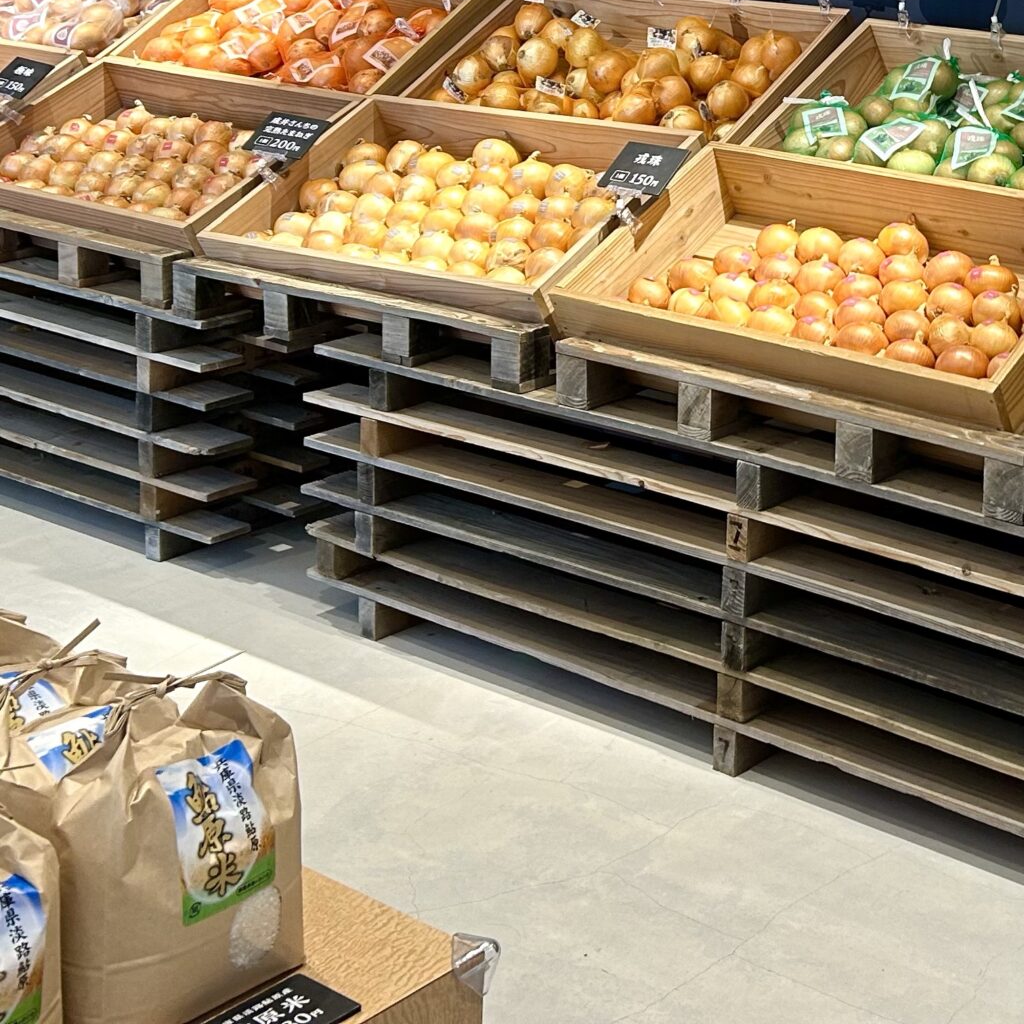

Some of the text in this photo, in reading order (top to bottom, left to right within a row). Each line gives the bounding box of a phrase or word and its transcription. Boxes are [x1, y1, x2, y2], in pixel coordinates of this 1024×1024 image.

[633, 152, 664, 167] 戎珠
[628, 172, 660, 188] 150円
[215, 757, 262, 852] 兵庫県淡路鮎原
